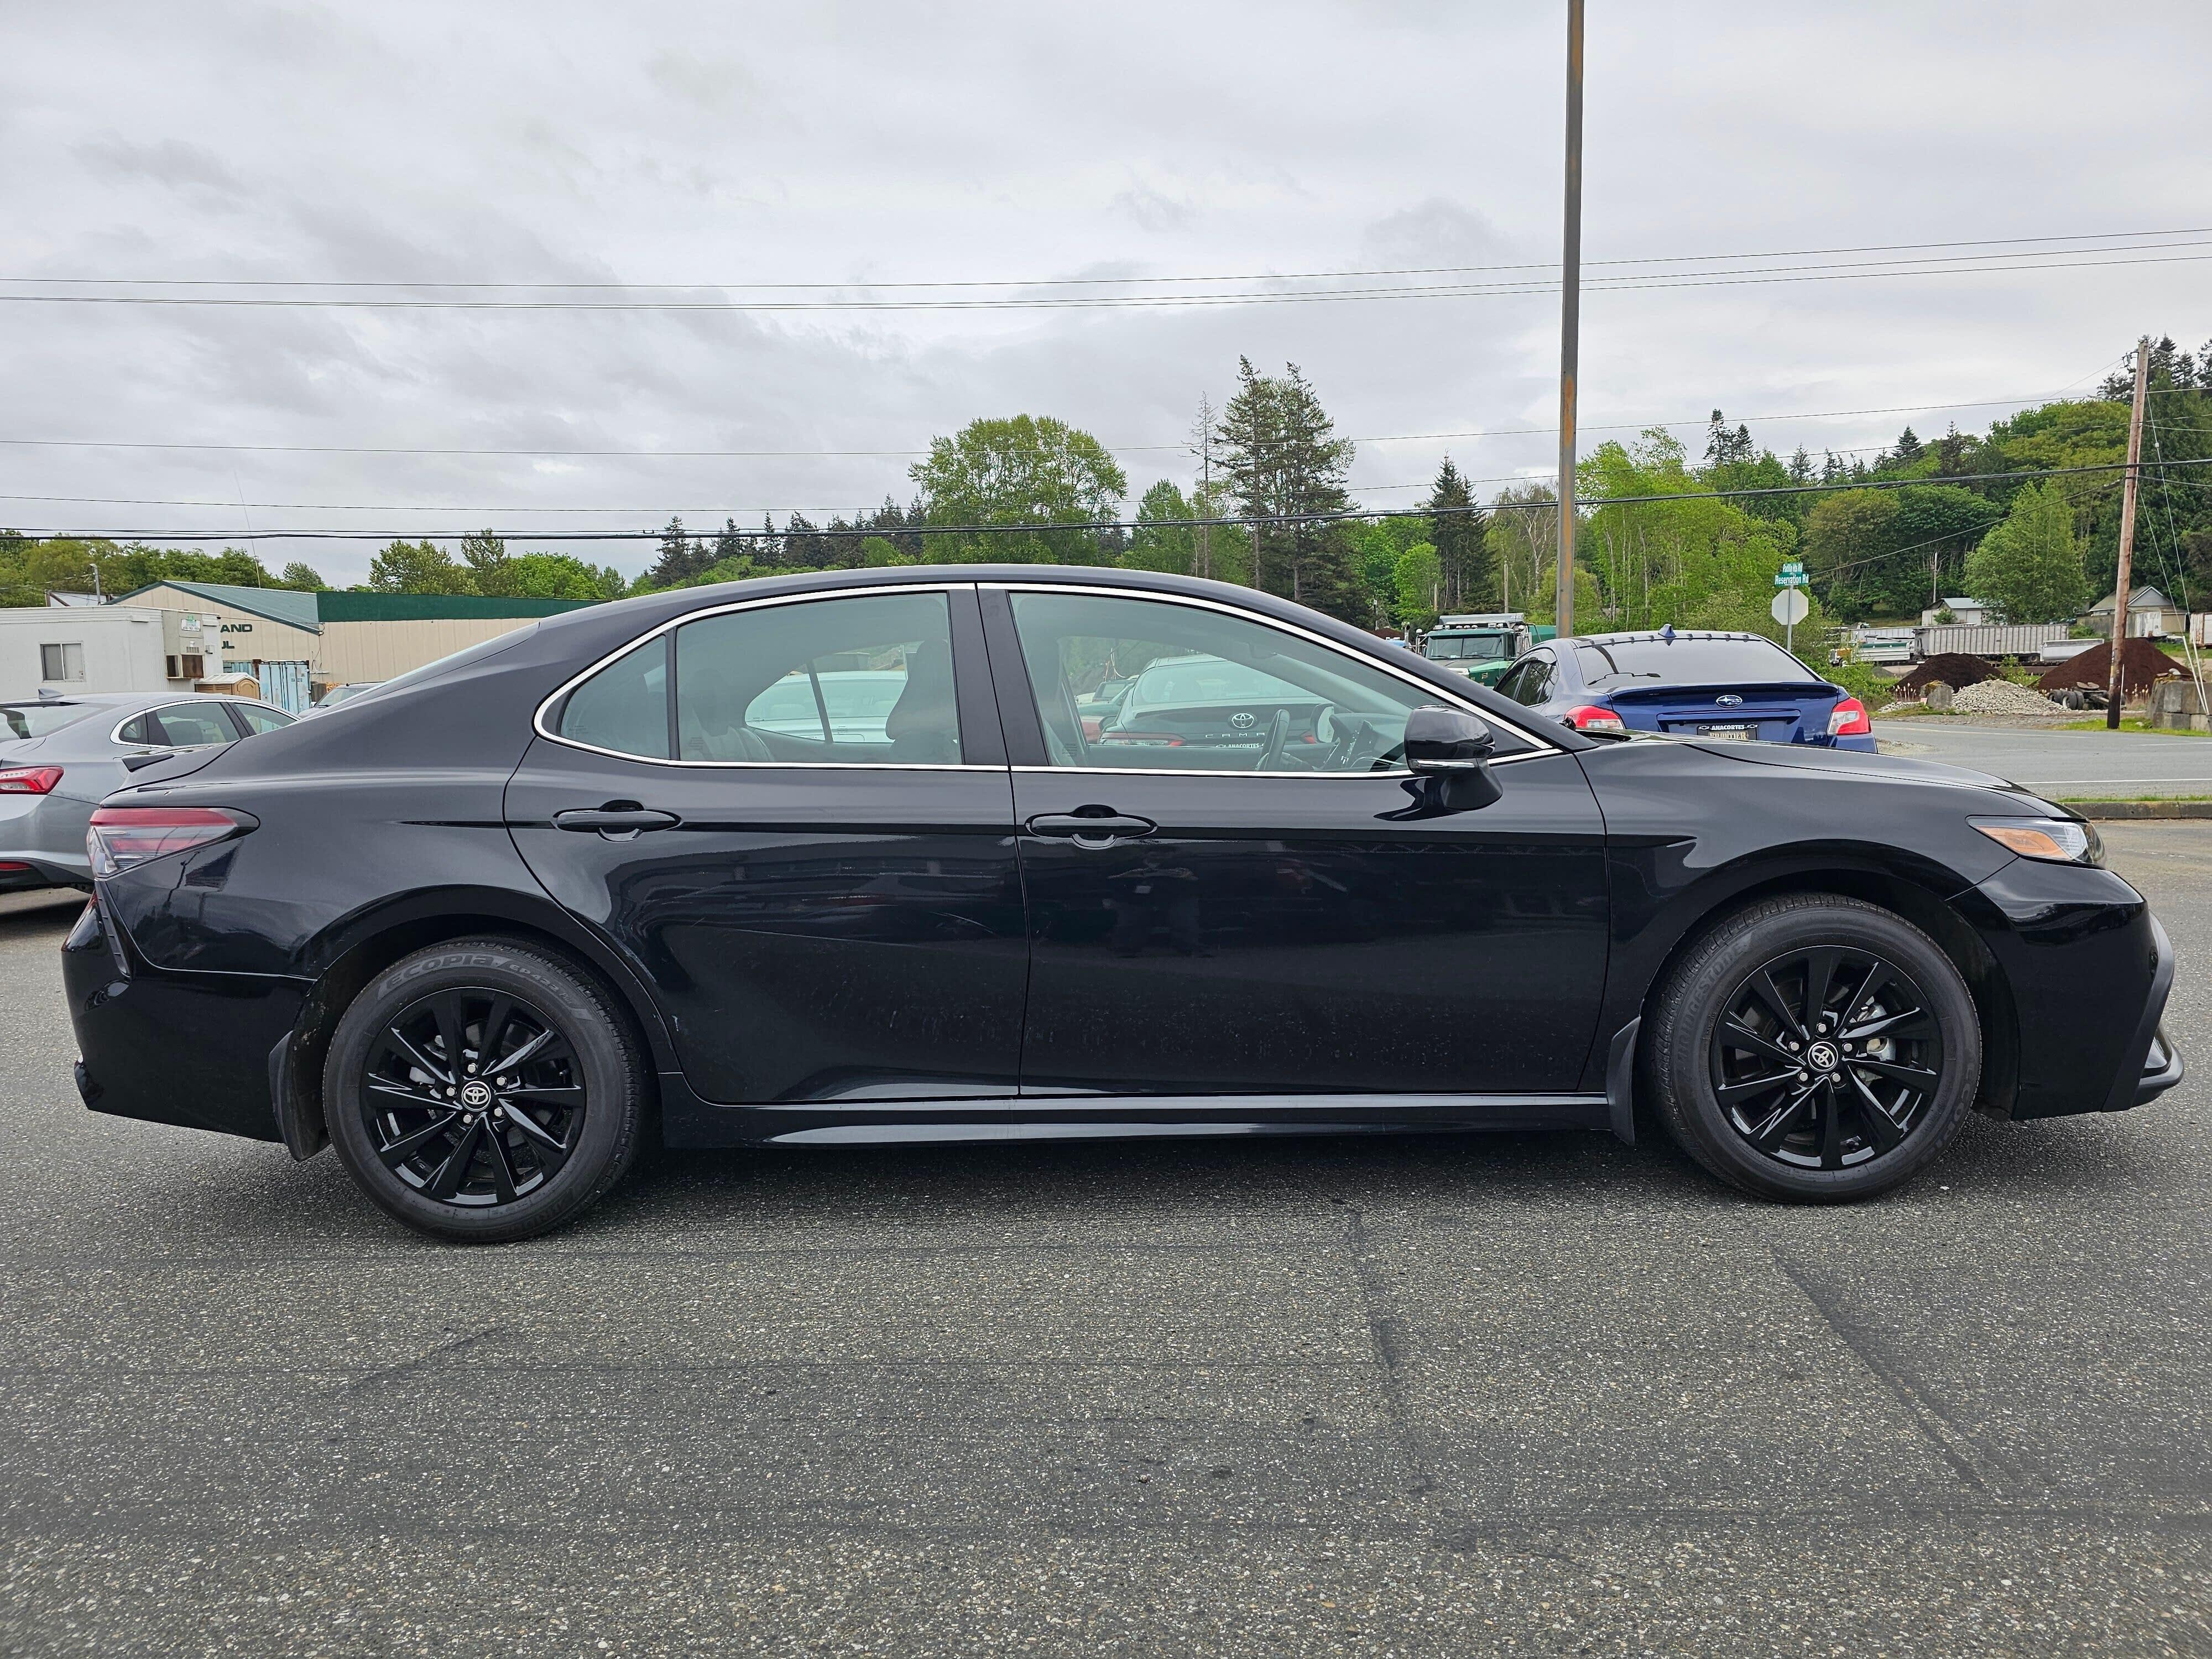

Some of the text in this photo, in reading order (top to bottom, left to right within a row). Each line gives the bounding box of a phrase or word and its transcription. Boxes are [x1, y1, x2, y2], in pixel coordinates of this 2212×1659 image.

[1798, 562, 1803, 572] Rd
[1775, 574, 1809, 585] Reservation Rd
[509, 964, 559, 992] EP422
